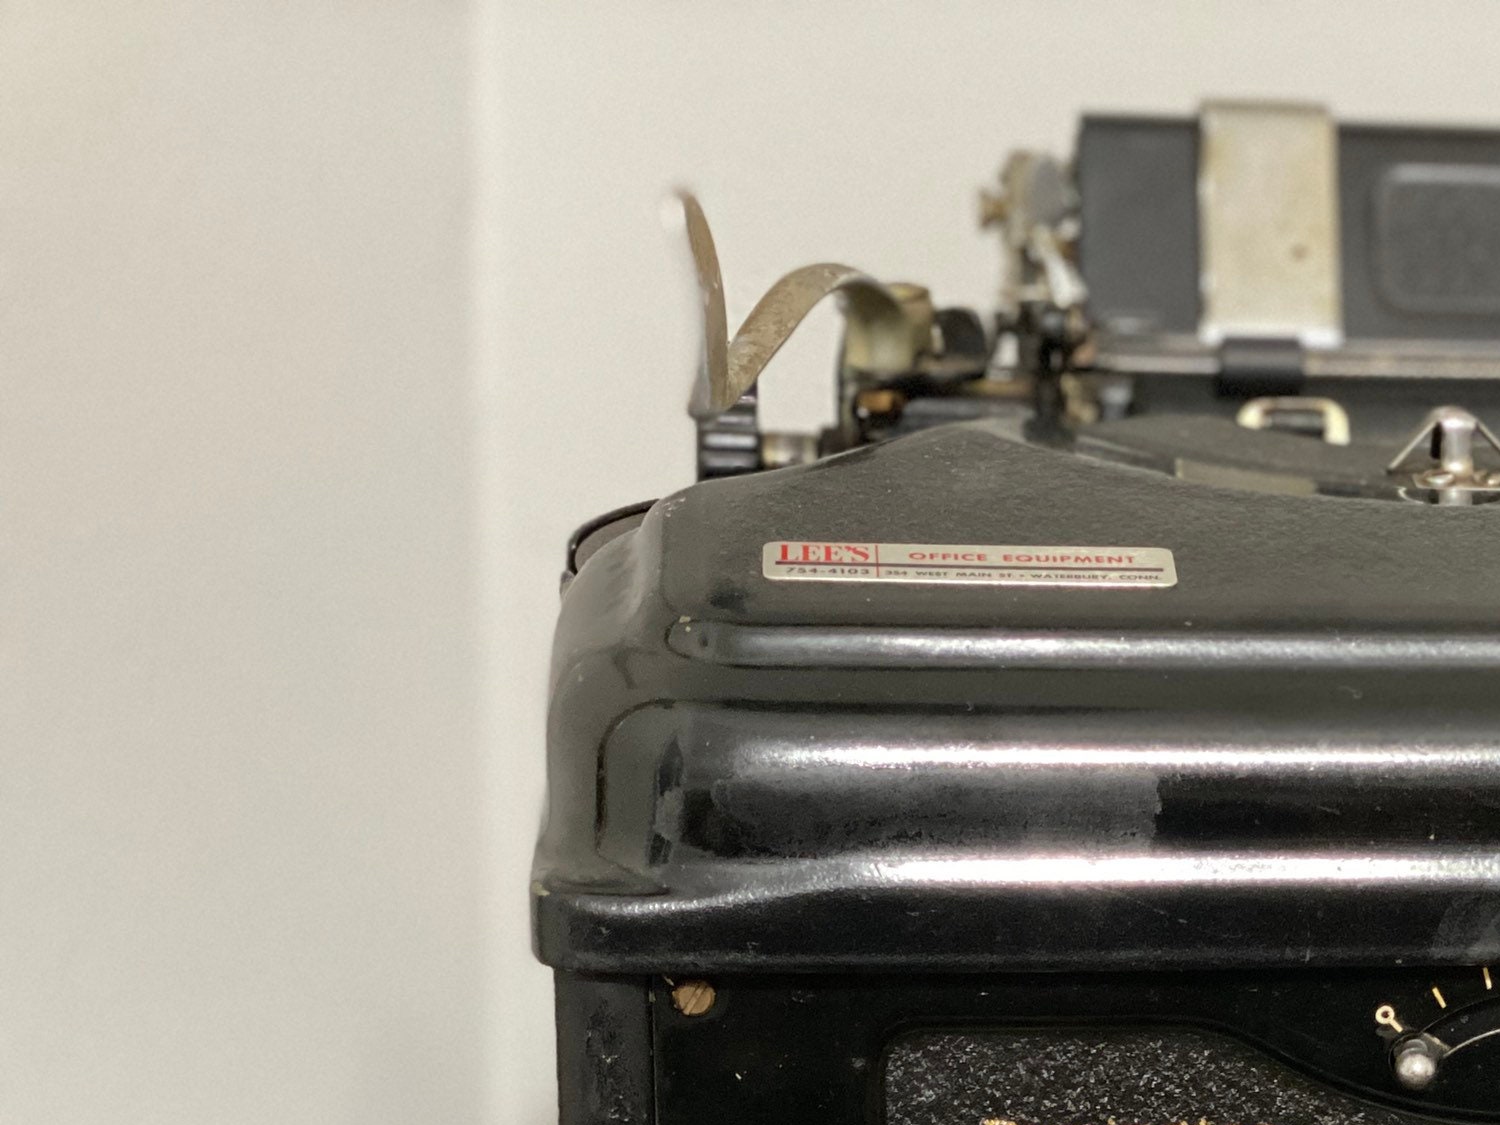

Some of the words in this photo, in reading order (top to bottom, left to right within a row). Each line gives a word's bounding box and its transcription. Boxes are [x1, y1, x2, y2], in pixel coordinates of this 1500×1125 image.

[780, 544, 870, 562] LEE'S
[908, 552, 988, 561] OFFICE
[1002, 553, 1135, 563] EQUIPMENT
[915, 570, 948, 578] WEST
